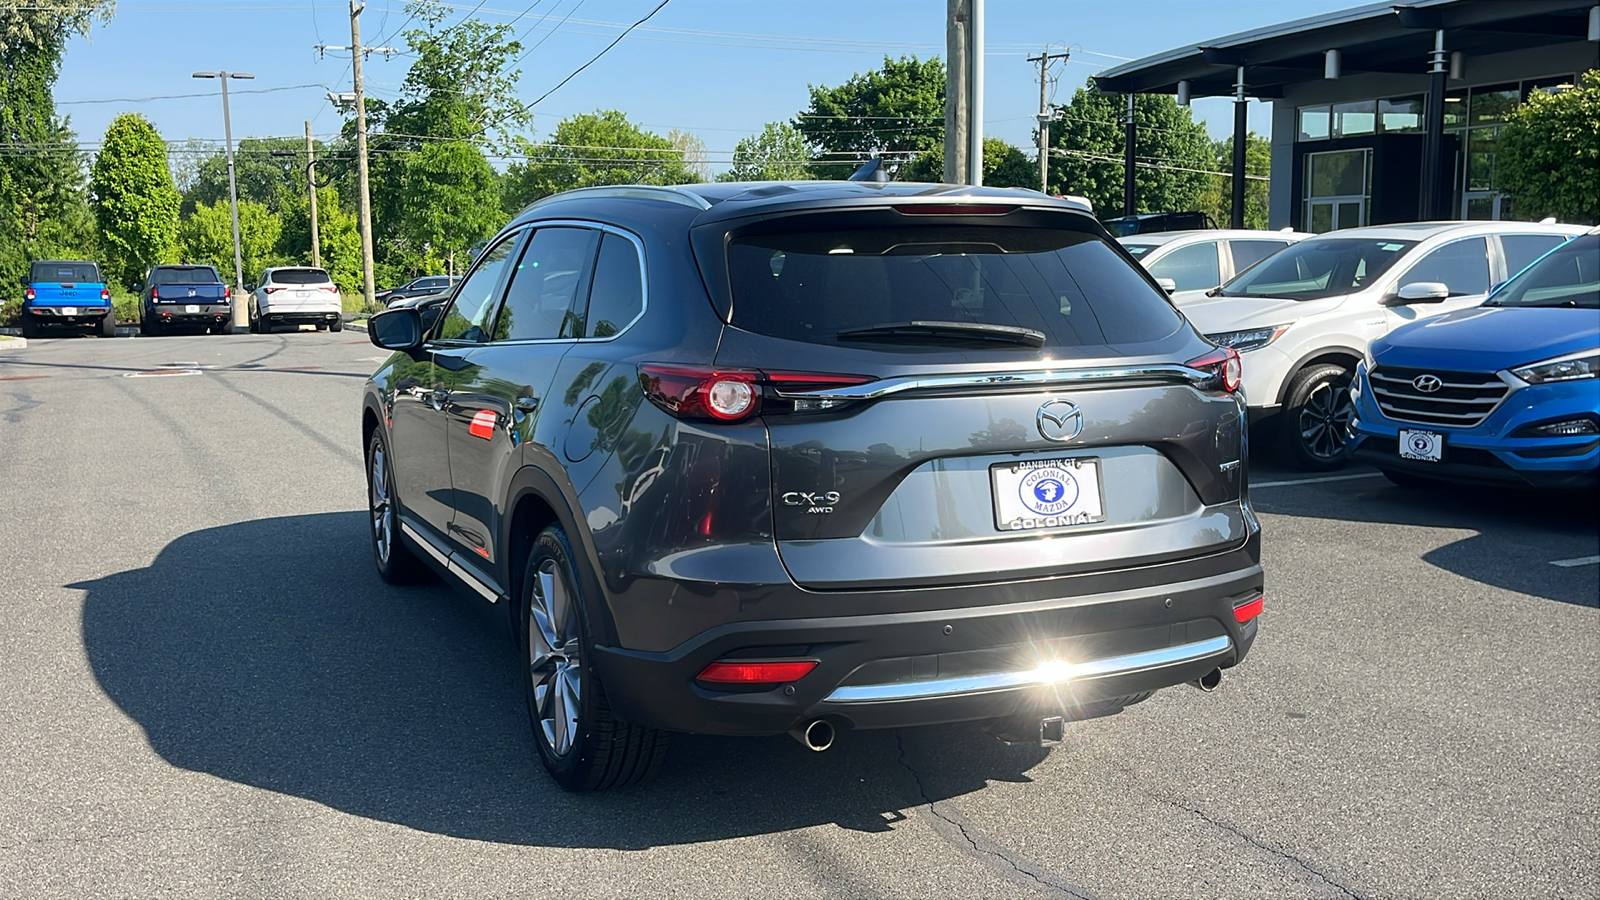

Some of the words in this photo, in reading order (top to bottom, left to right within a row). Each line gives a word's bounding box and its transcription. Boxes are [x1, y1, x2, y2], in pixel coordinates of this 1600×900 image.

[1401, 453, 1438, 462] COLONIAL
[1019, 459, 1062, 470] DANBURY
[1025, 469, 1071, 487] COLONIAL
[781, 491, 841, 506] CX-9
[806, 506, 834, 514] AWD
[1034, 499, 1069, 512] MAZDA
[1010, 514, 1098, 530] COLONIAL
